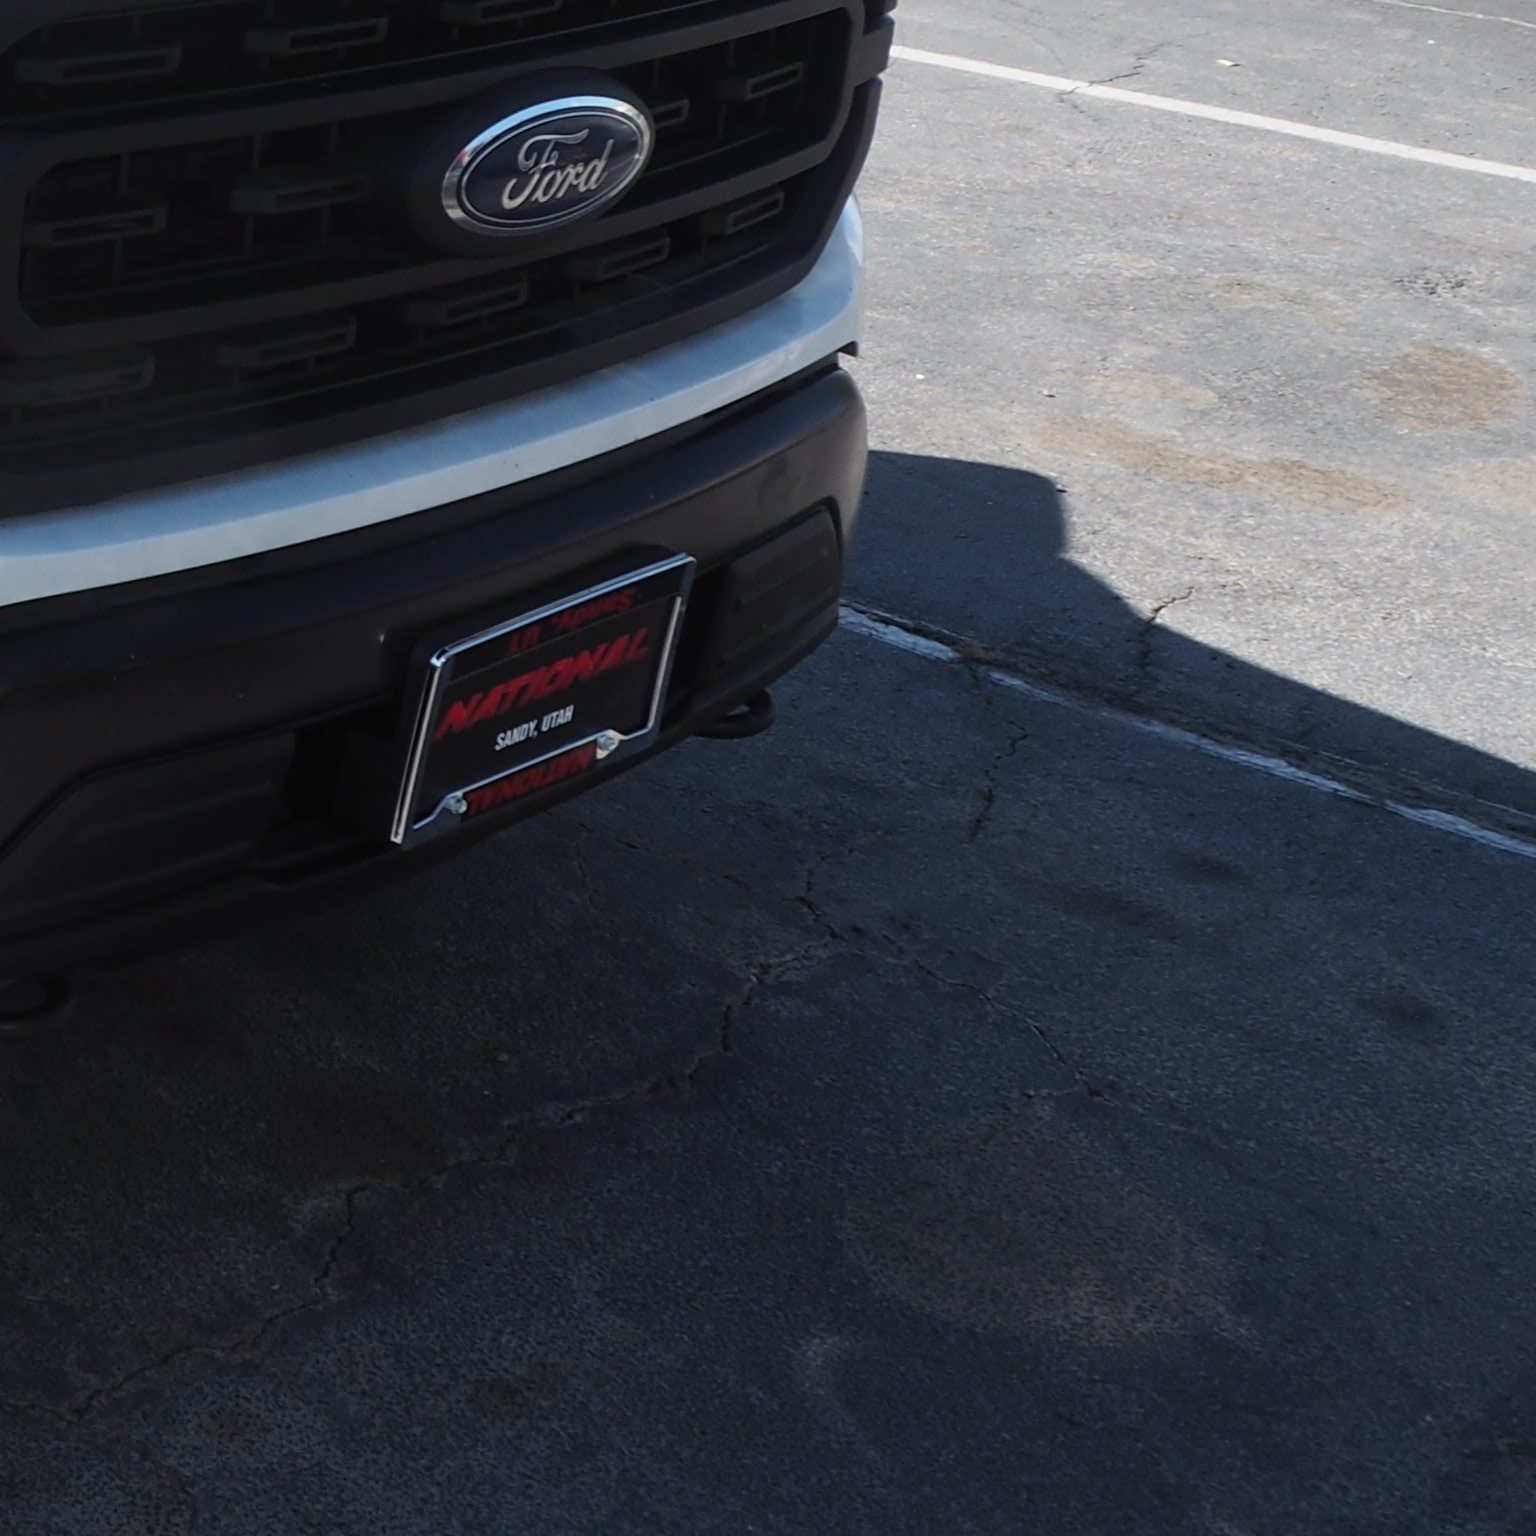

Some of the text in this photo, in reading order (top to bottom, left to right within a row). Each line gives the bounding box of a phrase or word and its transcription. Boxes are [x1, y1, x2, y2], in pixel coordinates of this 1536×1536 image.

[501, 128, 615, 210] Ford
[433, 627, 649, 742] NATIONAL
[495, 704, 575, 751] SANDY, UTAH
